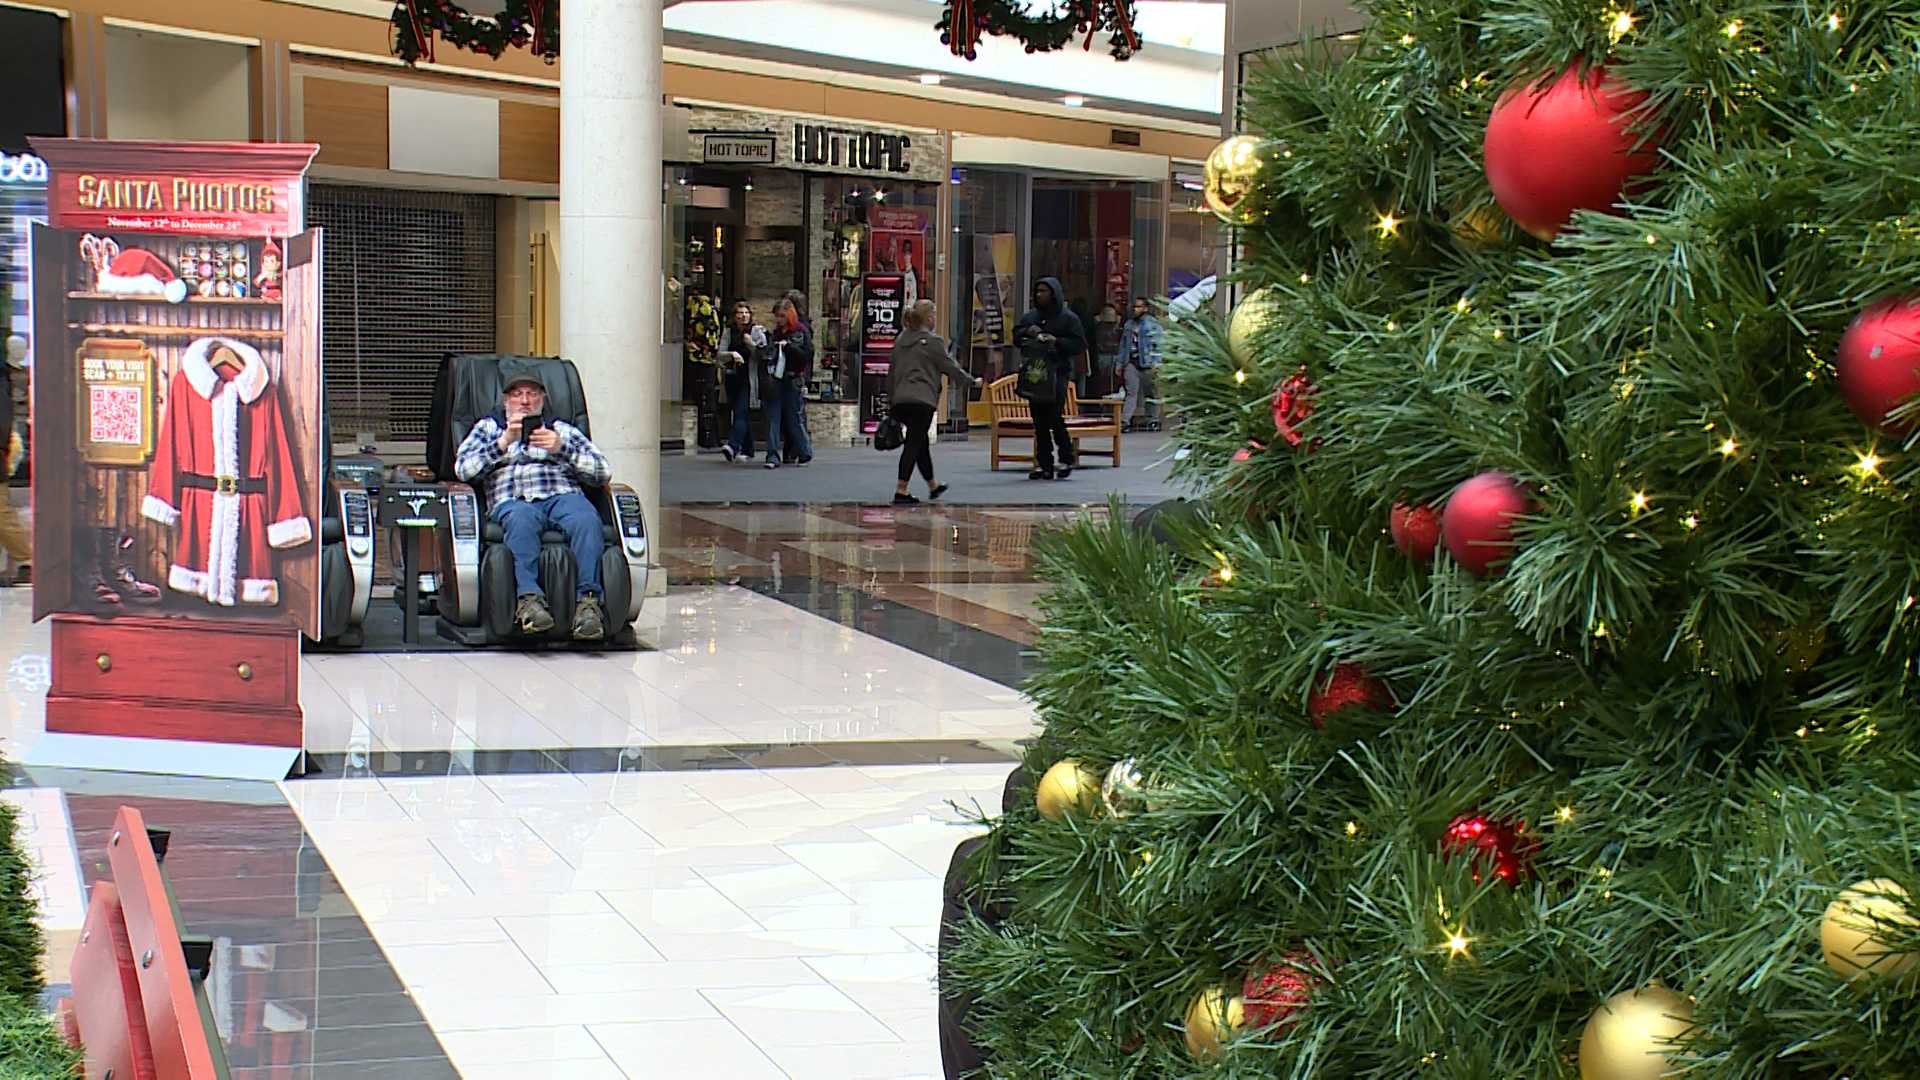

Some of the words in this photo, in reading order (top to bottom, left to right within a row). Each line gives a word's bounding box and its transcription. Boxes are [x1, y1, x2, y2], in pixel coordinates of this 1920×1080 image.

[709, 143, 734, 156] HOT
[735, 143, 768, 157] TOPIC
[78, 175, 164, 210] SANTA
[172, 176, 275, 213] PHOTOS
[107, 217, 152, 228] November
[171, 220, 181, 228] to
[181, 219, 224, 230] December
[126, 360, 145, 370] VISIT
